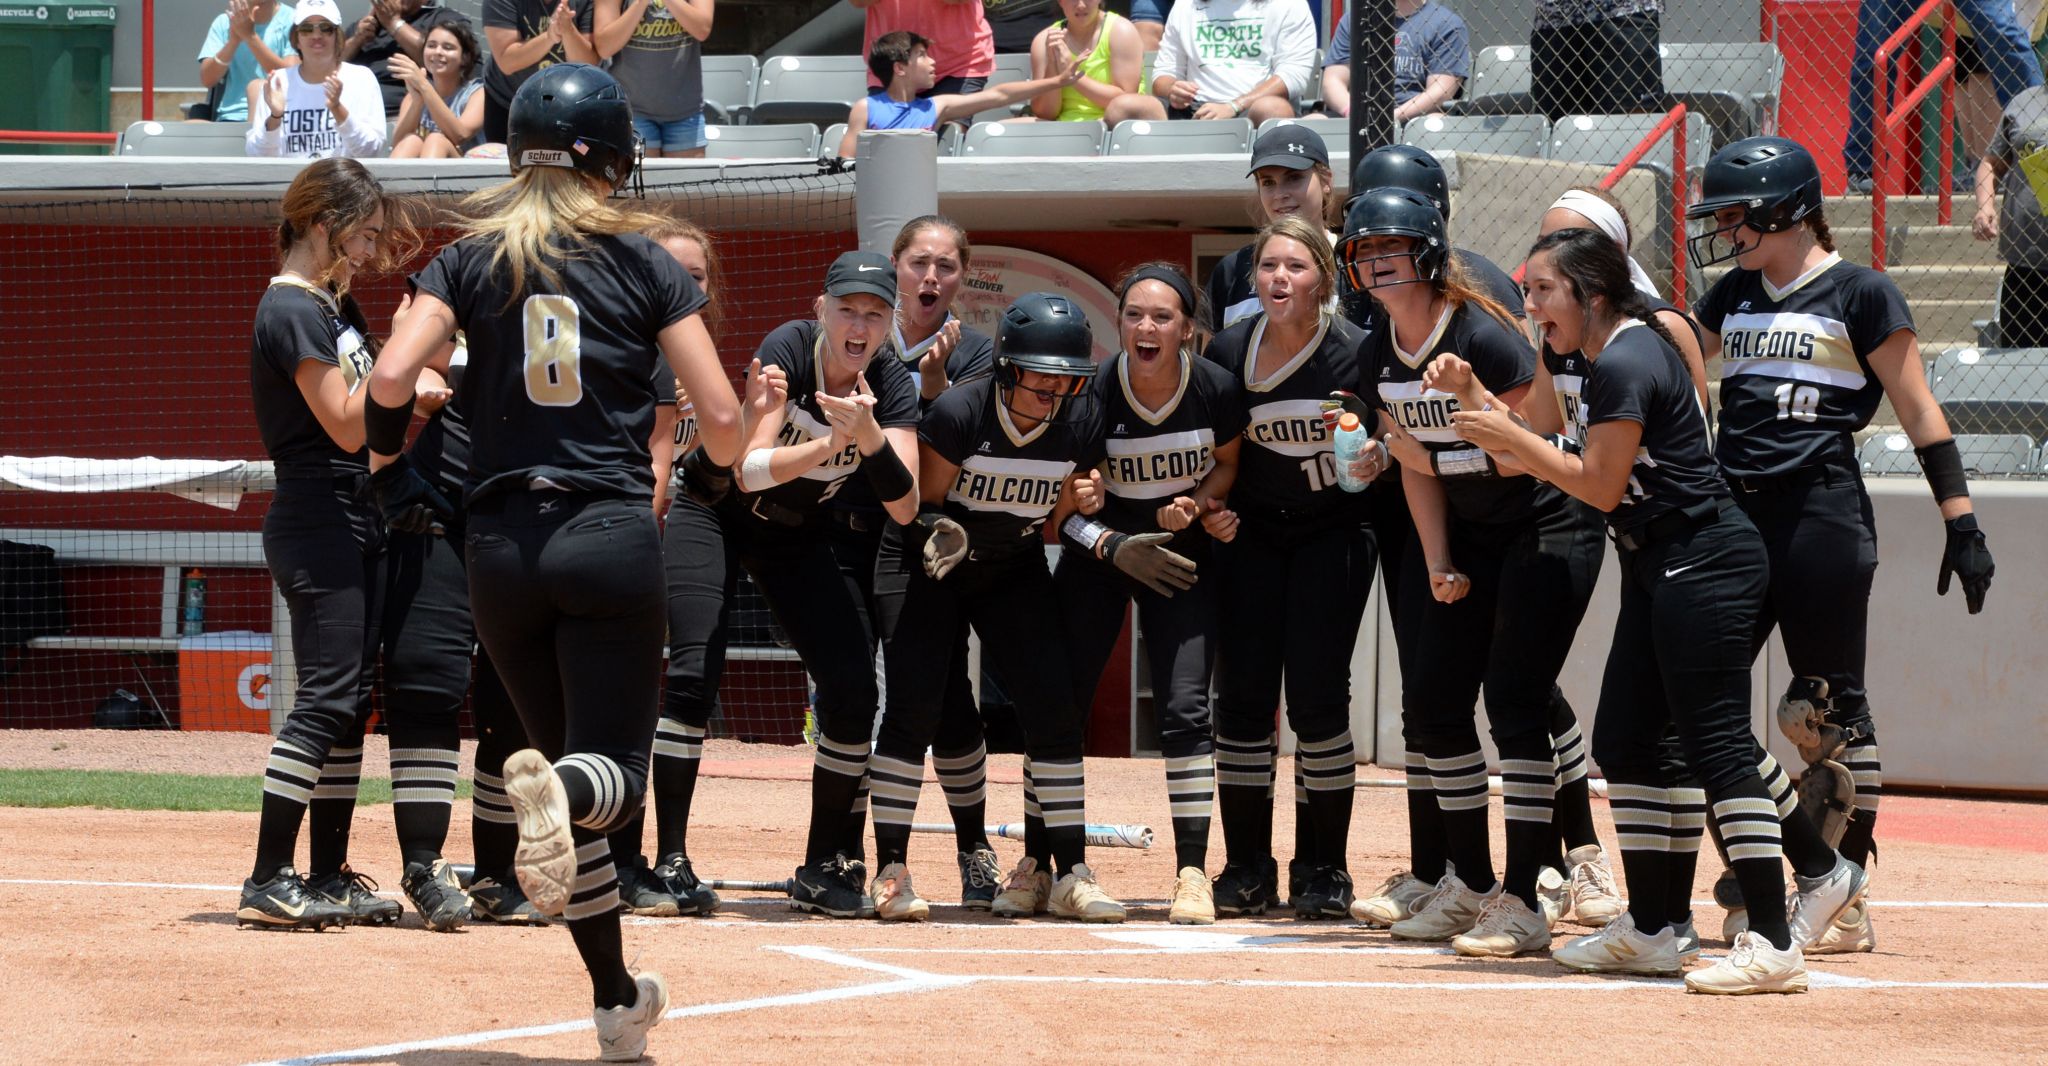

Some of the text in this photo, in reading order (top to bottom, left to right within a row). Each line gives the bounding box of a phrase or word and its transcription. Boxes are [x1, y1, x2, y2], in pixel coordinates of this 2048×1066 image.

[1196, 24, 1263, 42] NORTH
[1200, 42, 1262, 59] TEXAS
[283, 108, 335, 134] FOSTE
[528, 150, 562, 161] schutt
[966, 278, 1004, 293] KEOVER
[523, 294, 583, 407] 8
[1723, 330, 1815, 361] FALCONS
[1384, 398, 1460, 428] ALCONS
[1254, 418, 1326, 443] CONS
[1106, 446, 1209, 483] FALCONS
[955, 468, 1062, 506] FALCONS
[1085, 835, 1113, 848] VILLE
